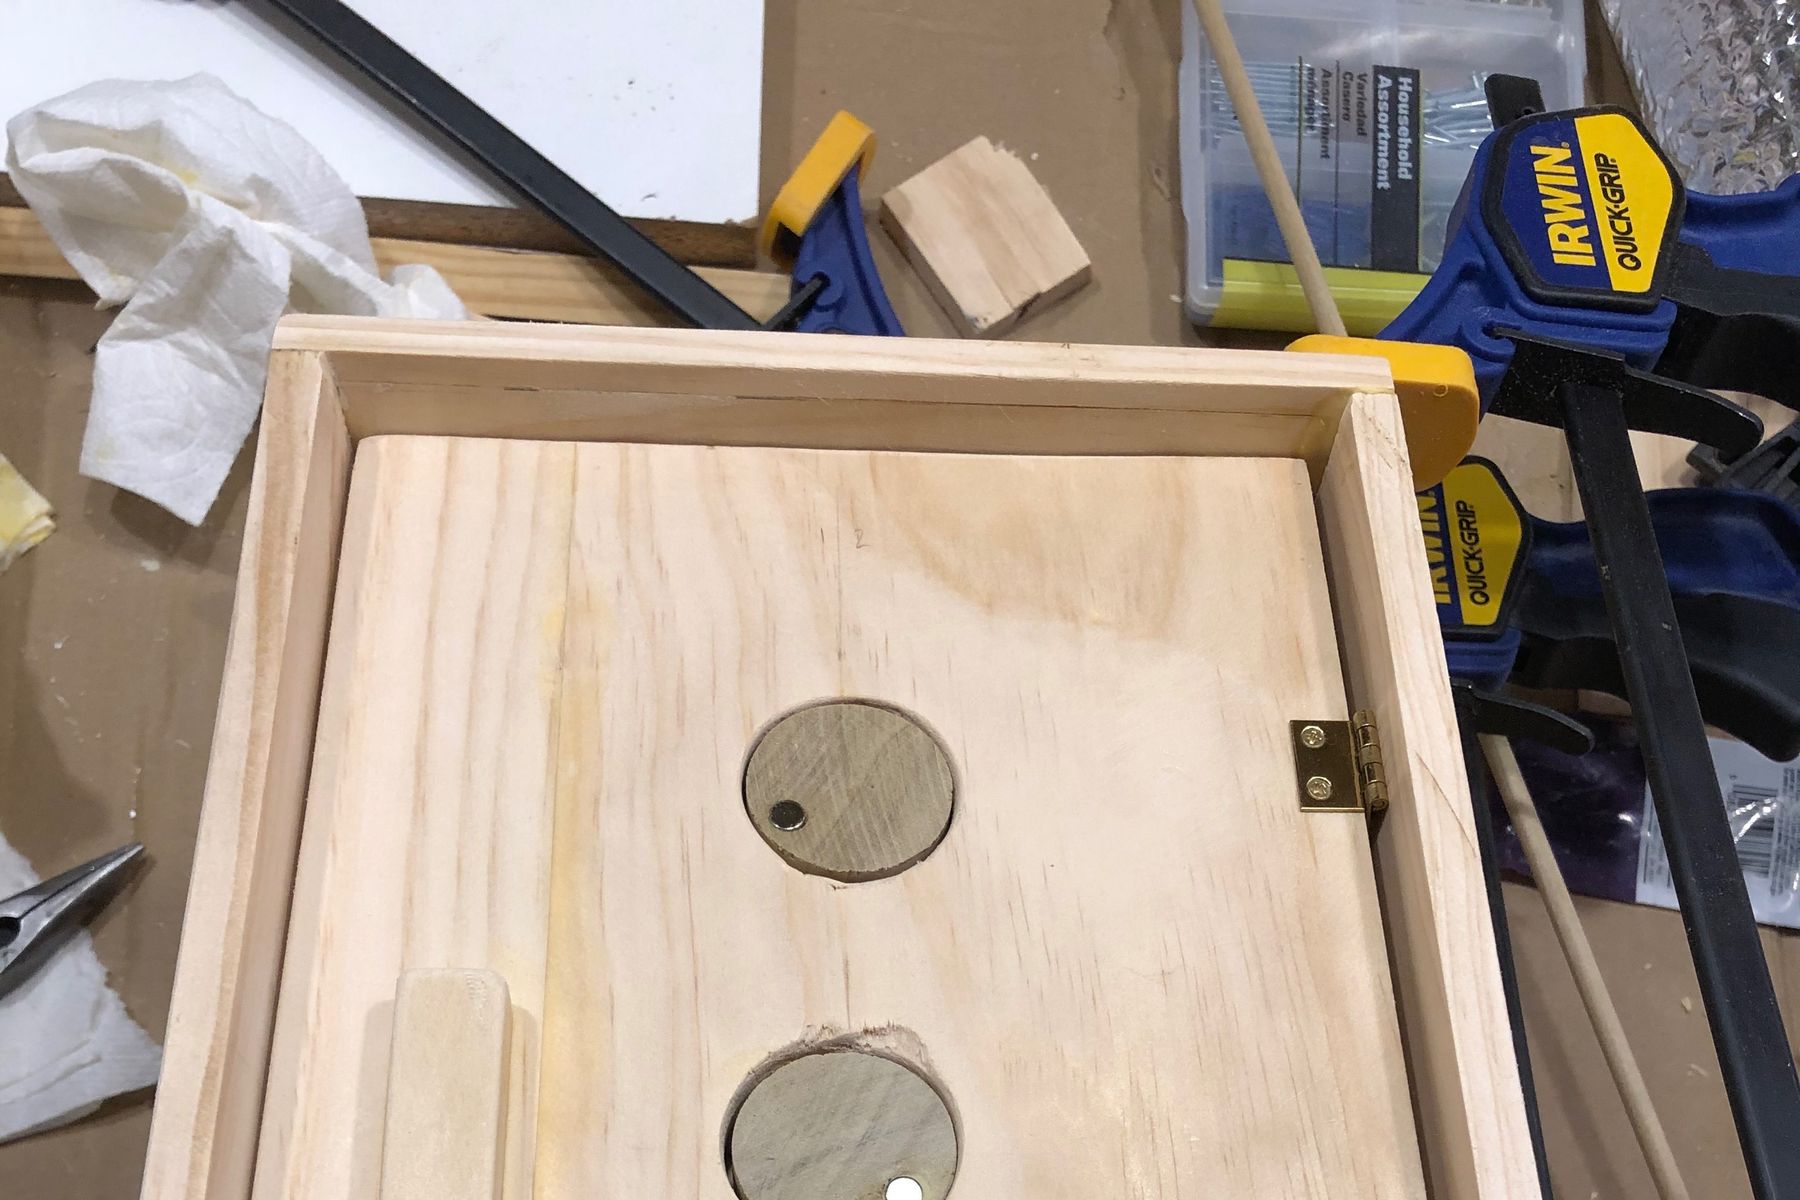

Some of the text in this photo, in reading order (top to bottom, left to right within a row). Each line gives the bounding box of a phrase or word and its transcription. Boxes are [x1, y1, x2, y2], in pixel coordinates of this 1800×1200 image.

[1342, 71, 1354, 122] Casero
[1356, 72, 1368, 137] Variedad
[1377, 74, 1393, 190] Assortment
[1397, 76, 1413, 180] Household
[1530, 145, 1597, 267] IRWIN
